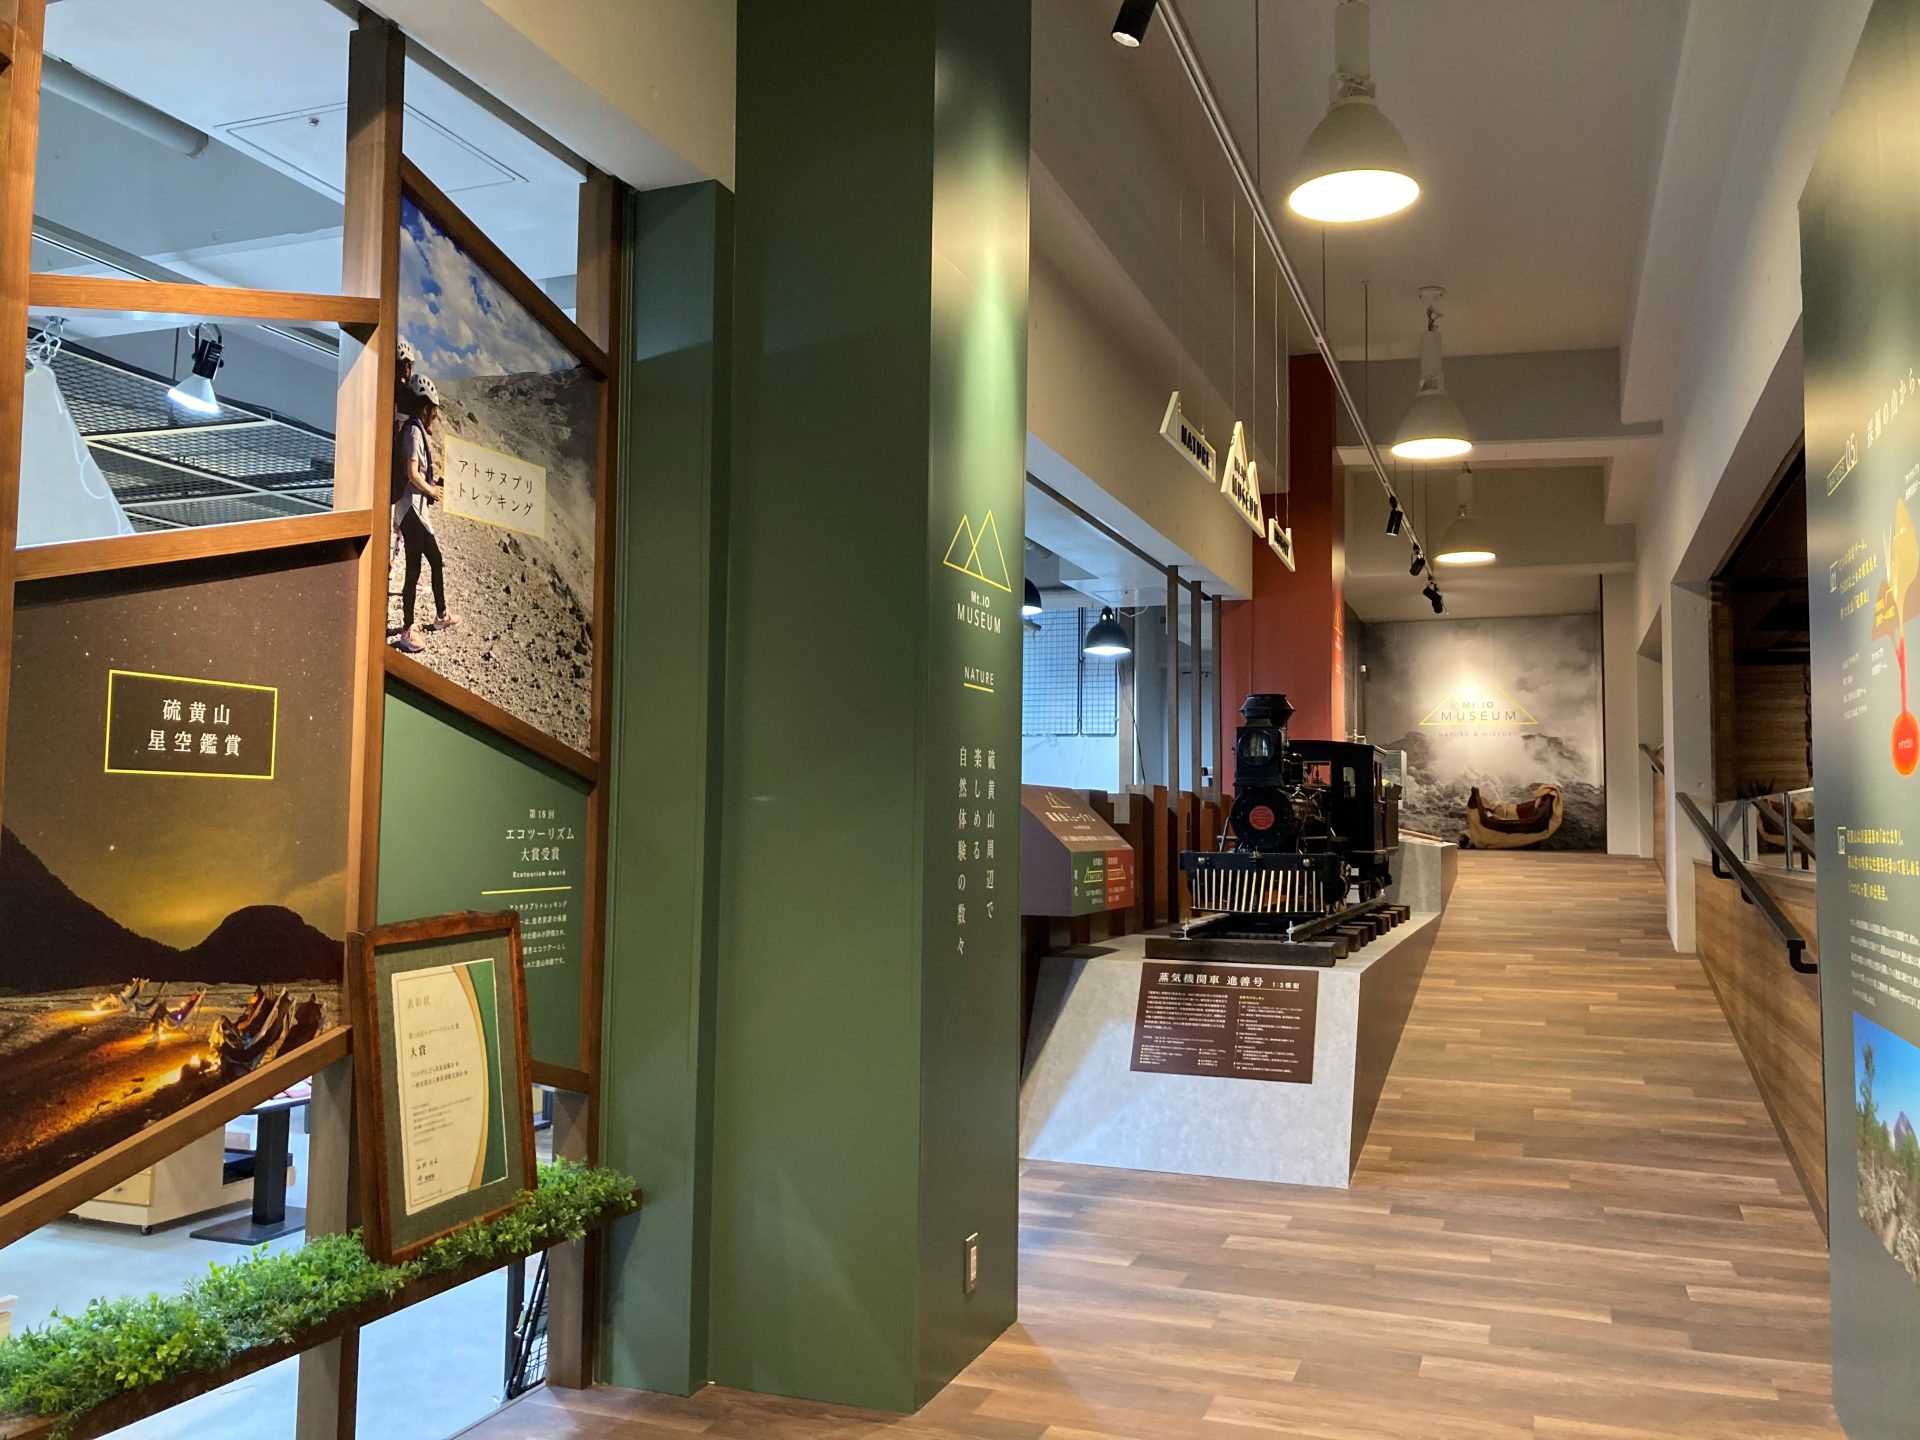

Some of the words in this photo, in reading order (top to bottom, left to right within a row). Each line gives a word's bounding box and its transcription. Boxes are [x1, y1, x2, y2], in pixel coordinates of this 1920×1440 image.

[458, 459, 533, 494] アトサヌプリ
[458, 483, 534, 517] トレッキング
[957, 603, 1001, 634] MUSEUM
[964, 666, 995, 686] NATURE
[162, 698, 231, 726] 硫黄山
[1440, 711, 1517, 721] MUSEUM
[147, 729, 242, 757] 星空鑑賞
[973, 747, 982, 860] 楽しめる
[505, 827, 575, 841] エコツーリズム
[986, 749, 996, 919] 硫黄山周辺で
[520, 847, 560, 863] 大賞受賞
[957, 745, 967, 955] 自然体験の数々
[512, 870, 546, 878] Ecotourism
[548, 869, 567, 877] Award
[1158, 971, 1220, 985] 蒸気機関車
[410, 1044, 428, 1058] 大賞
